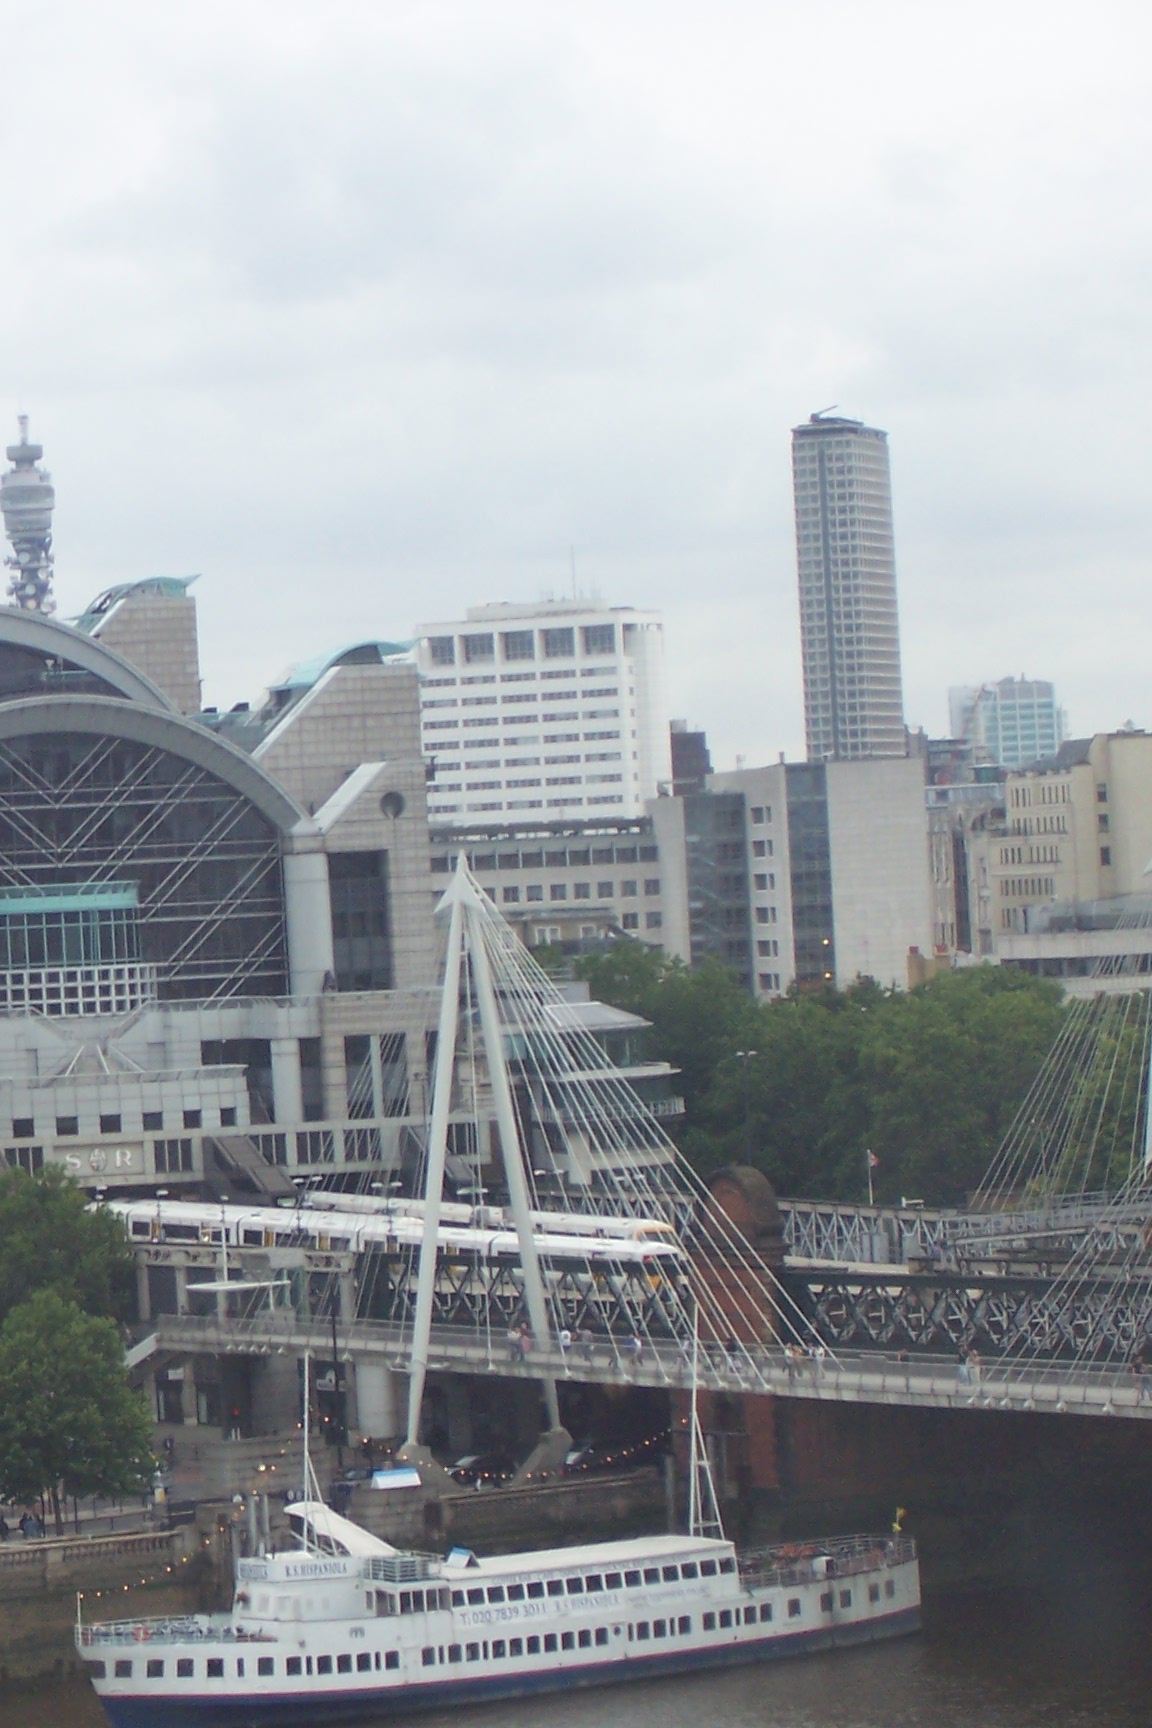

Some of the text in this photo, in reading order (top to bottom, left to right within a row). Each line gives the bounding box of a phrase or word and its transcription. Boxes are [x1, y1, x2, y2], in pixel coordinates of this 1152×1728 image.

[65, 1149, 132, 1169] S R
[472, 1611, 492, 1624] 020
[522, 1603, 547, 1617] 3011
